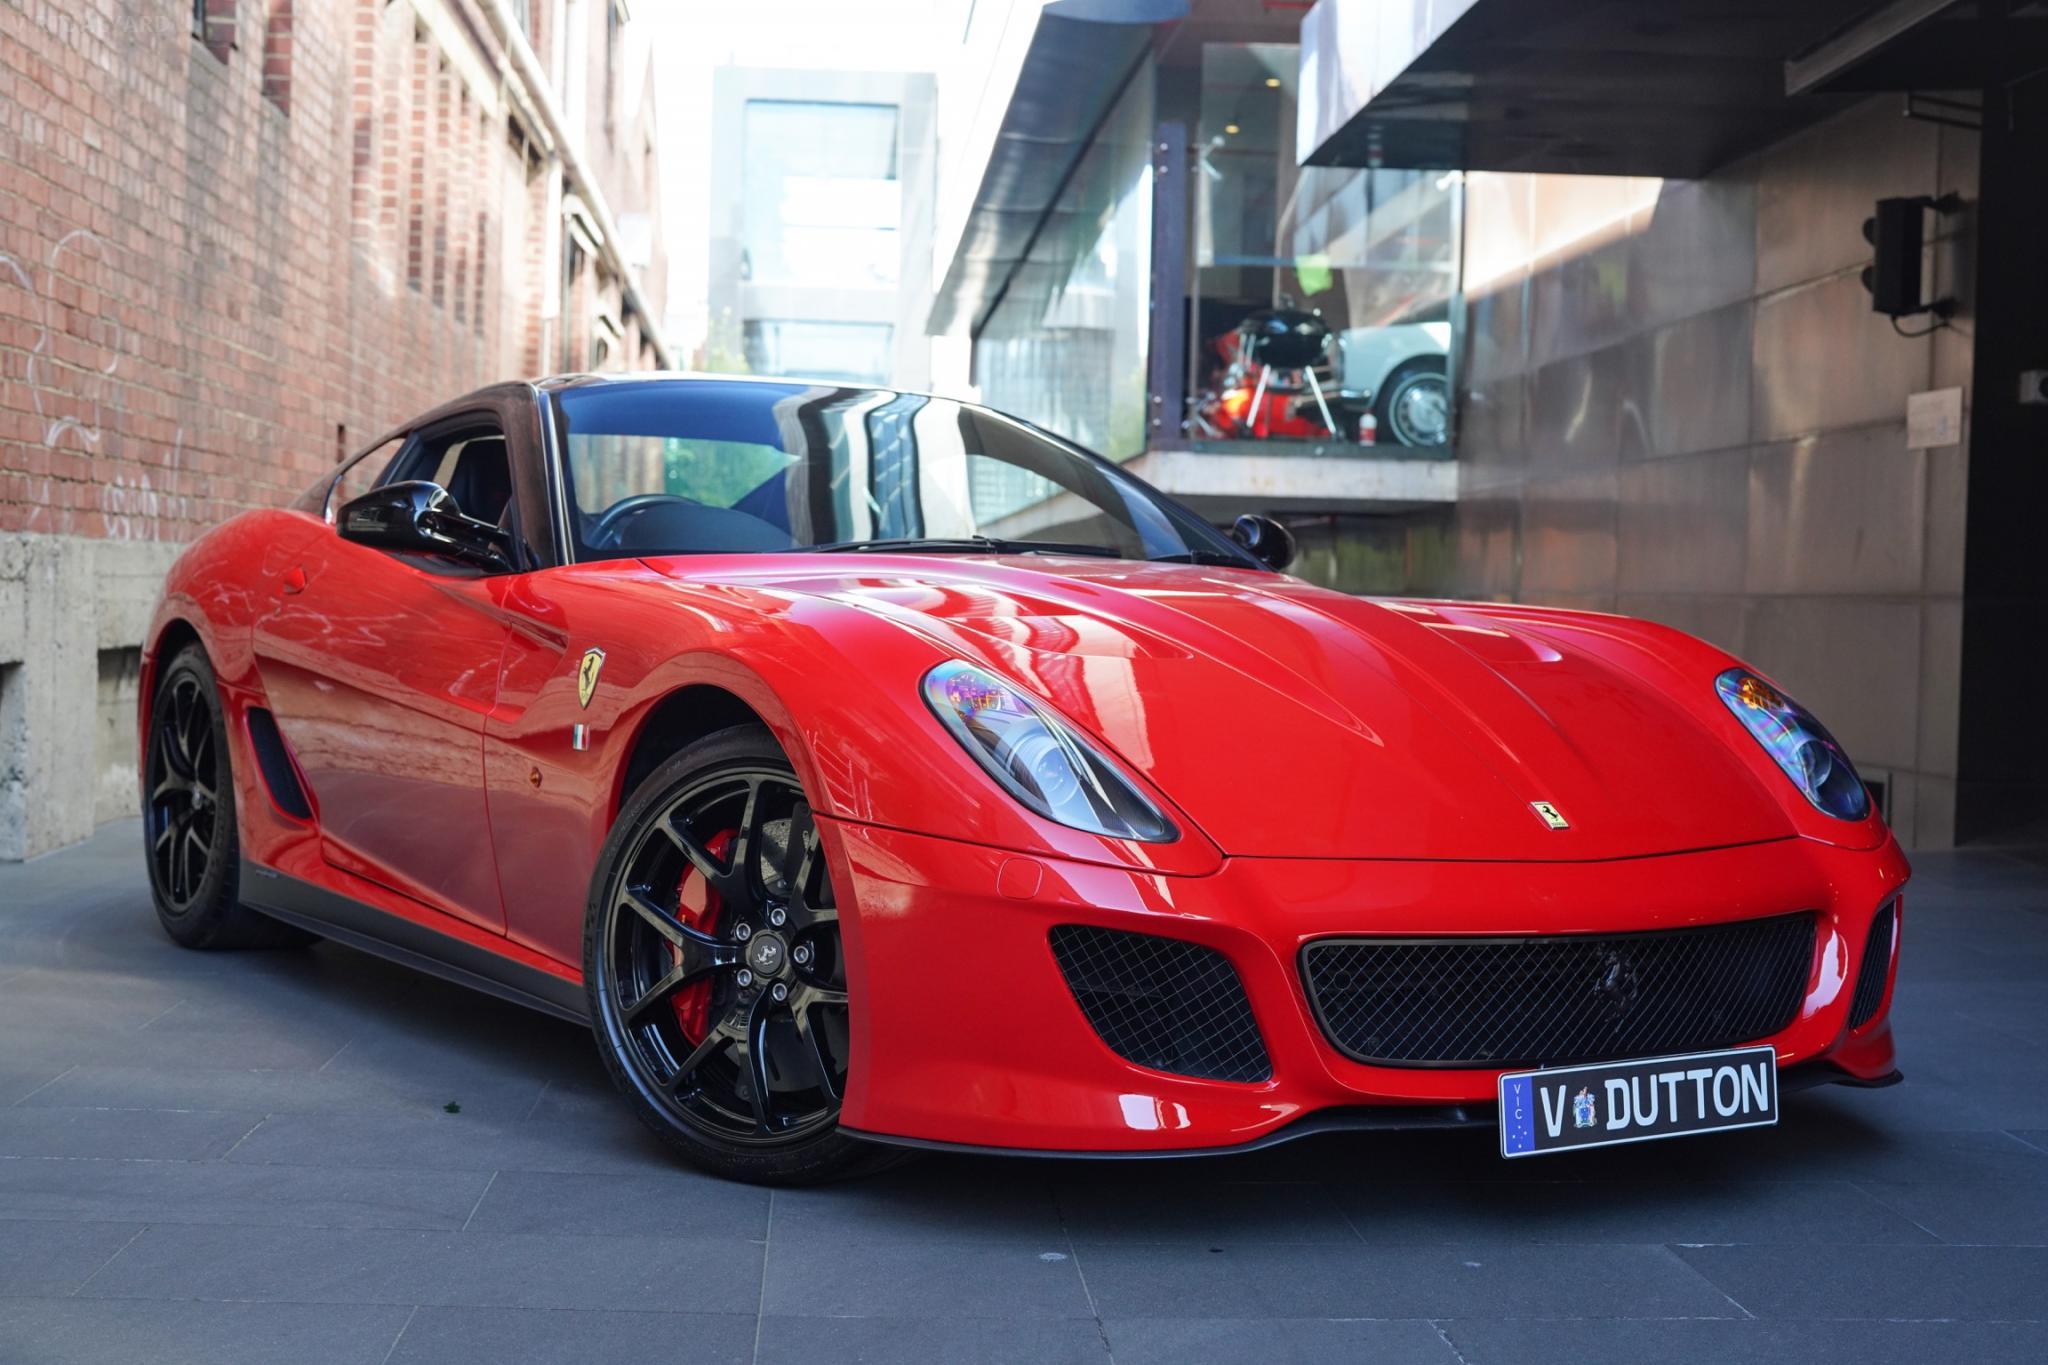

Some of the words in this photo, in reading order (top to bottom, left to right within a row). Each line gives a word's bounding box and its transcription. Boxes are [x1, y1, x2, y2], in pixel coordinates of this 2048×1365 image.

[1513, 1084, 1523, 1120] VIC
[1540, 1085, 1566, 1137] V
[1604, 1062, 1769, 1130] DUTTON
